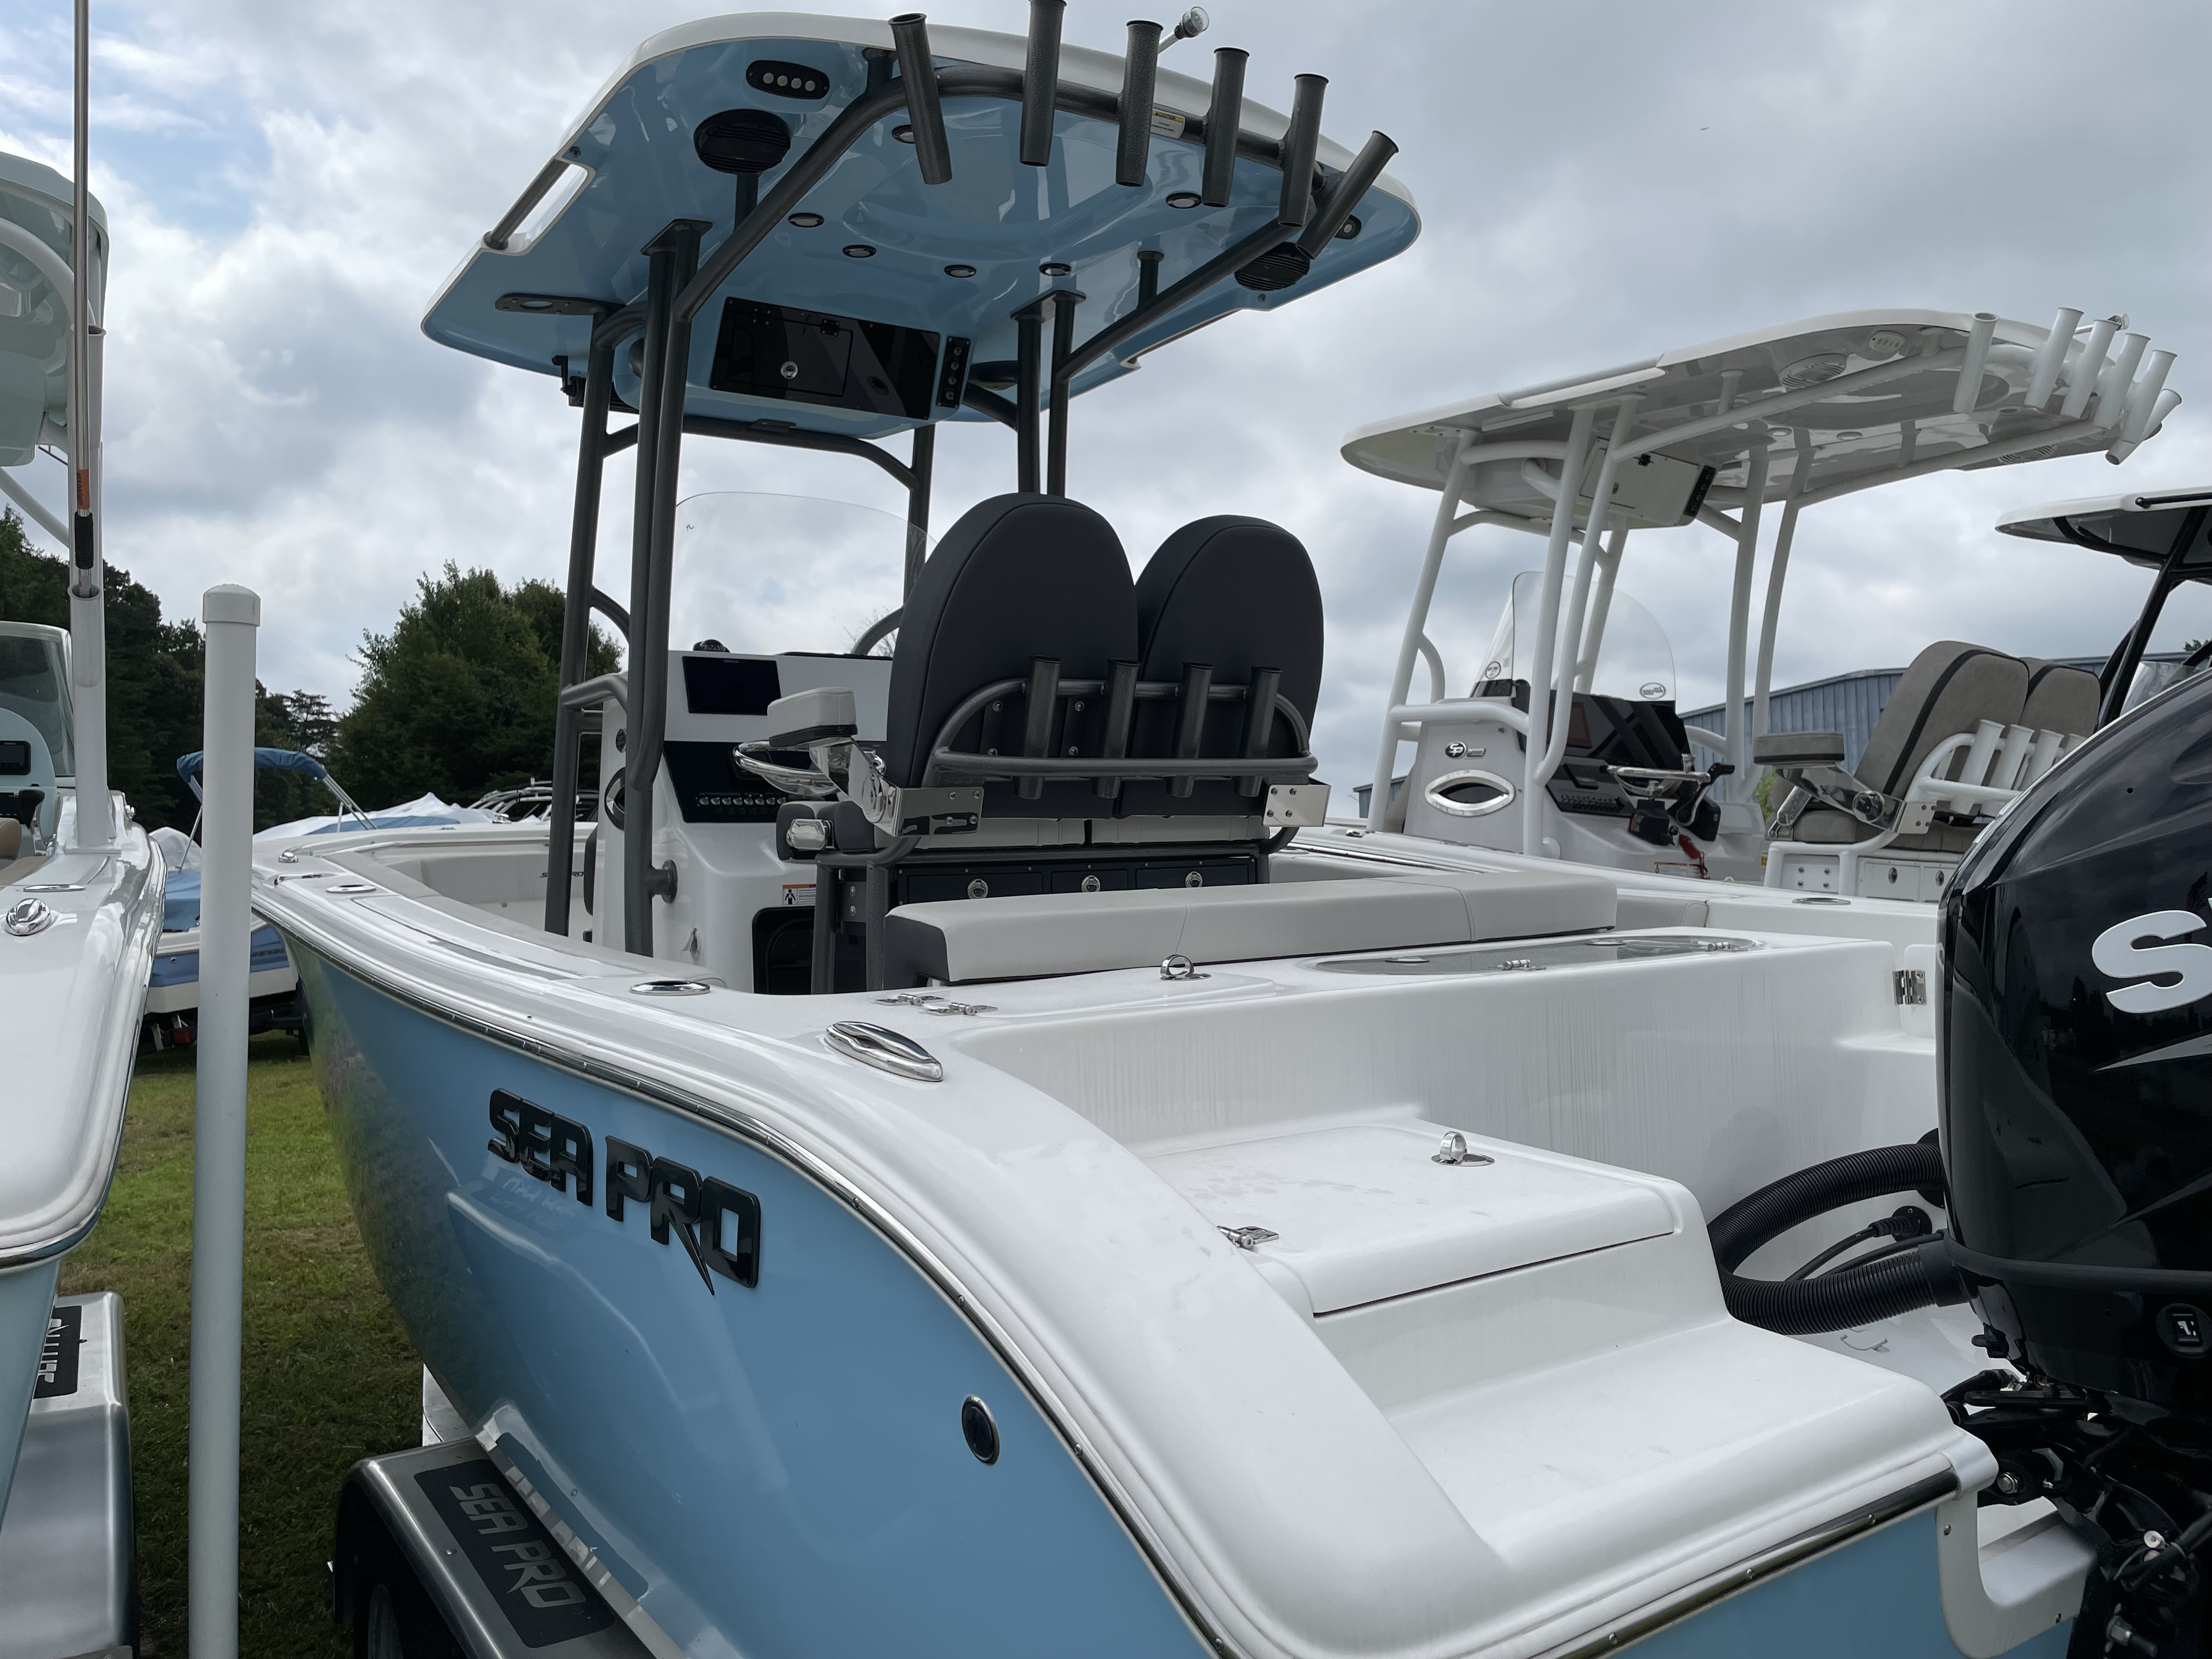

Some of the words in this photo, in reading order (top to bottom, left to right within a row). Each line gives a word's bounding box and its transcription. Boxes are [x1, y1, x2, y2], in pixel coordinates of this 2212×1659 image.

[2092, 898, 2212, 1014] S
[488, 1088, 593, 1206] SEA
[605, 1135, 761, 1296] PRO
[449, 1483, 529, 1534] SEA
[490, 1540, 586, 1608] PRO
